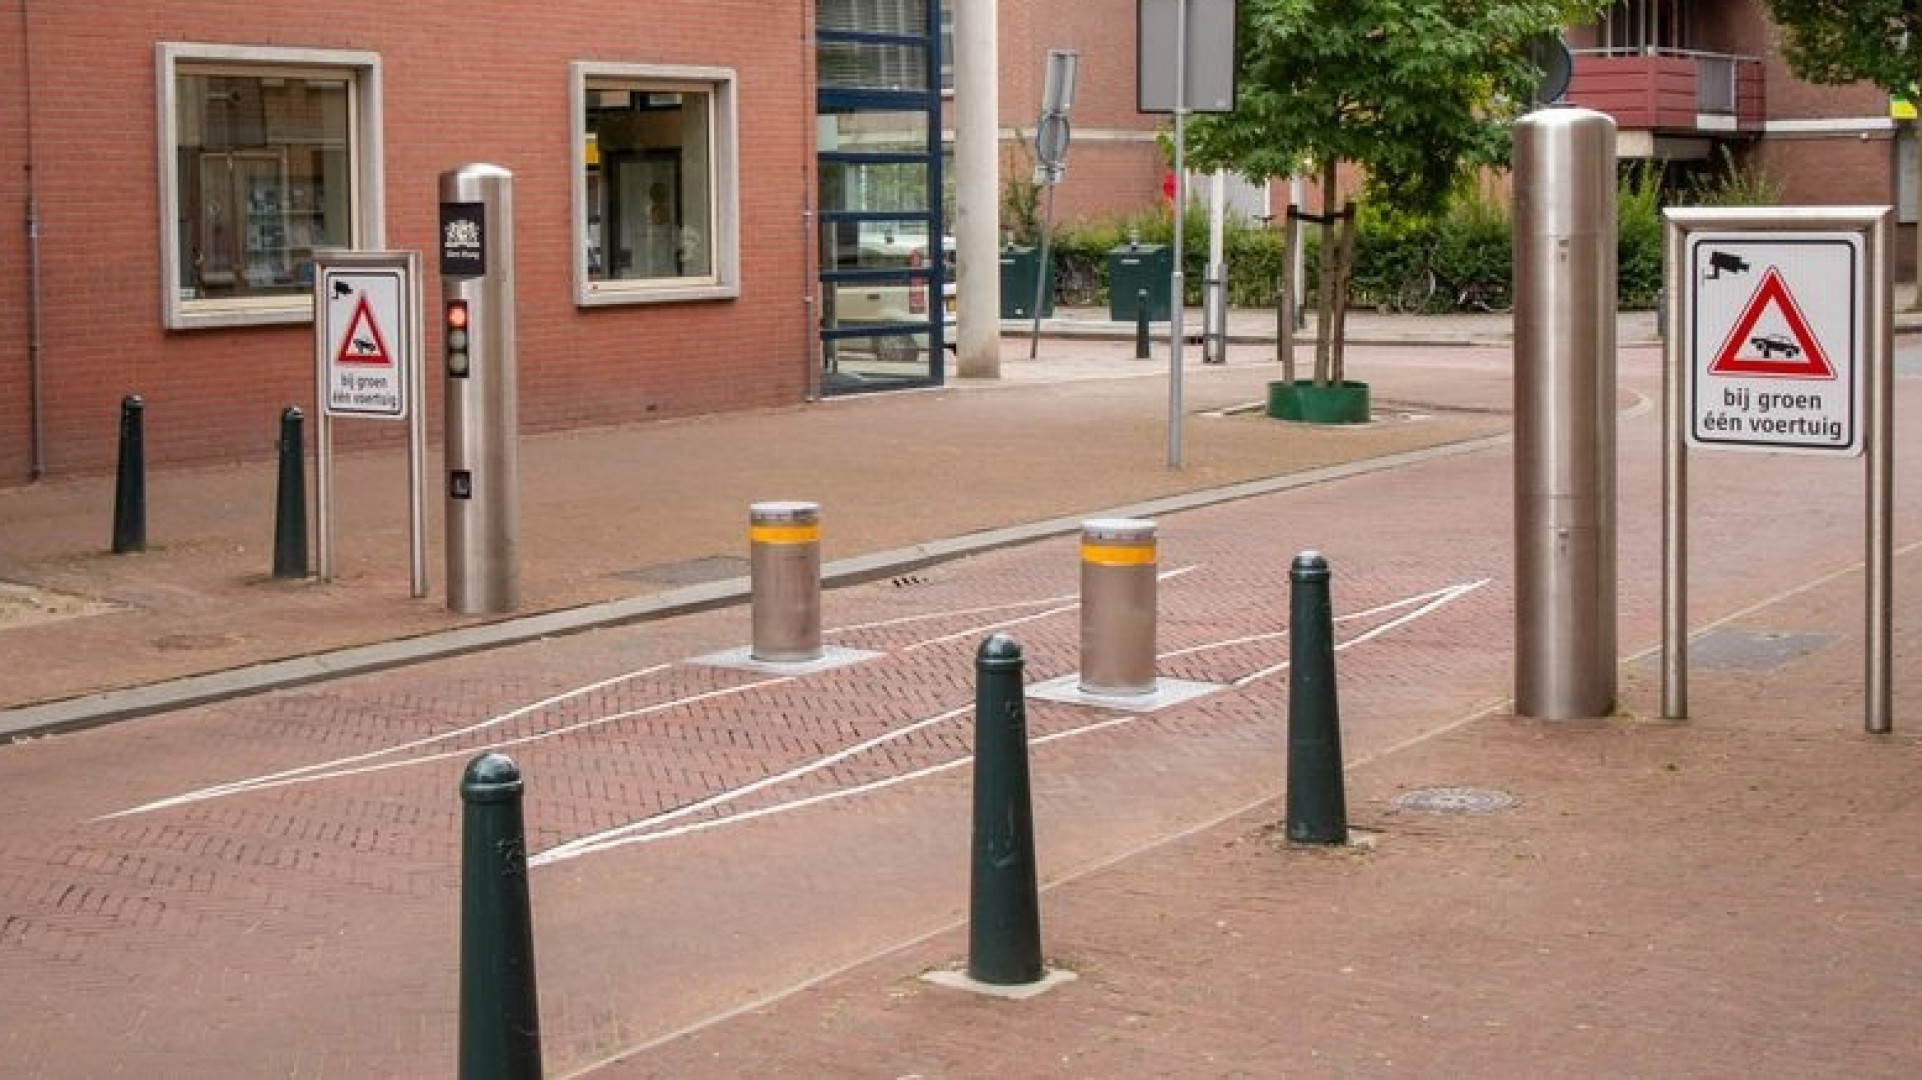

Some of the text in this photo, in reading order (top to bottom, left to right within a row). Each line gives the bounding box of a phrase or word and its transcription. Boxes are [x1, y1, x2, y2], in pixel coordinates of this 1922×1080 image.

[341, 373, 388, 391] bij groen
[352, 393, 396, 408] voertuig
[1723, 387, 1822, 413] bij groen
[1704, 410, 1842, 440] één voertuig
